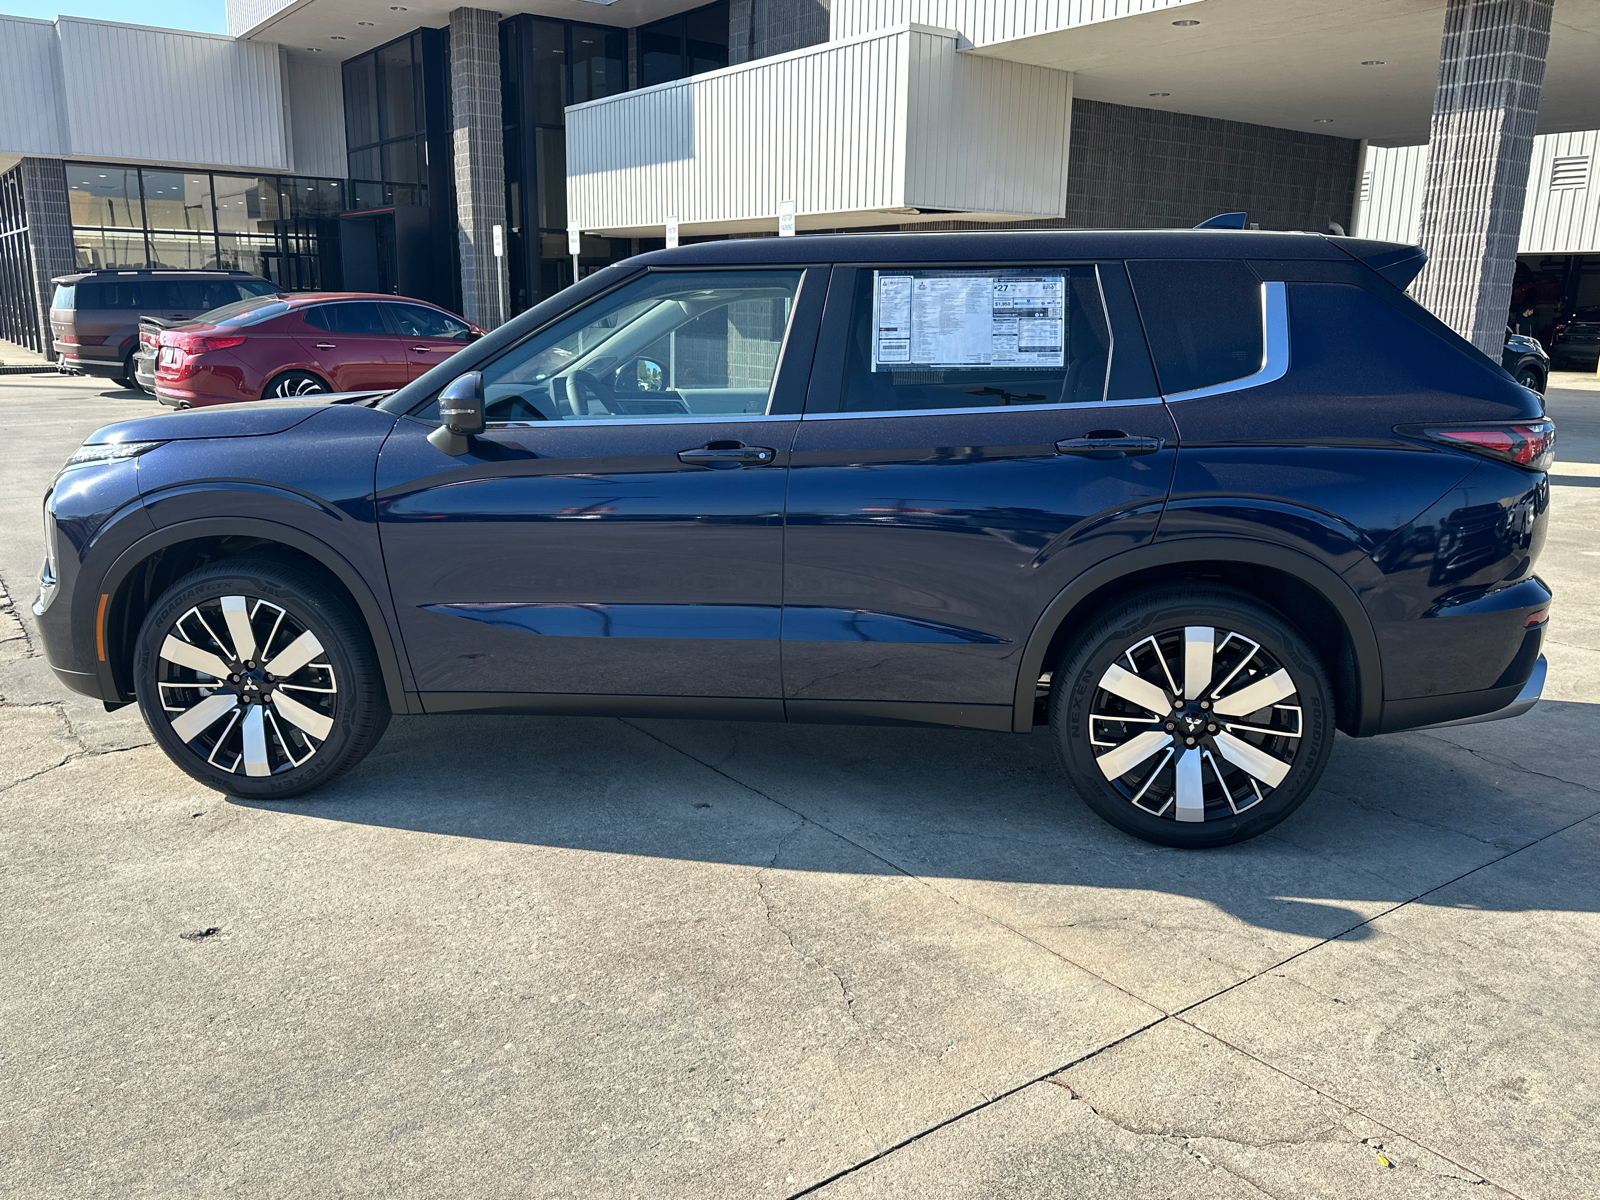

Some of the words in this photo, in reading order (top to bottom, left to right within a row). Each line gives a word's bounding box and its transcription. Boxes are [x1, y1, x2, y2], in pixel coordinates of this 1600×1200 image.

[997, 284, 1009, 292] 27
[155, 584, 205, 628] ROADIAN
[207, 582, 233, 591] GTX
[1071, 669, 1095, 738] NEXEN
[1305, 696, 1322, 770] ROADIAN
[270, 758, 328, 791] NEXEN
